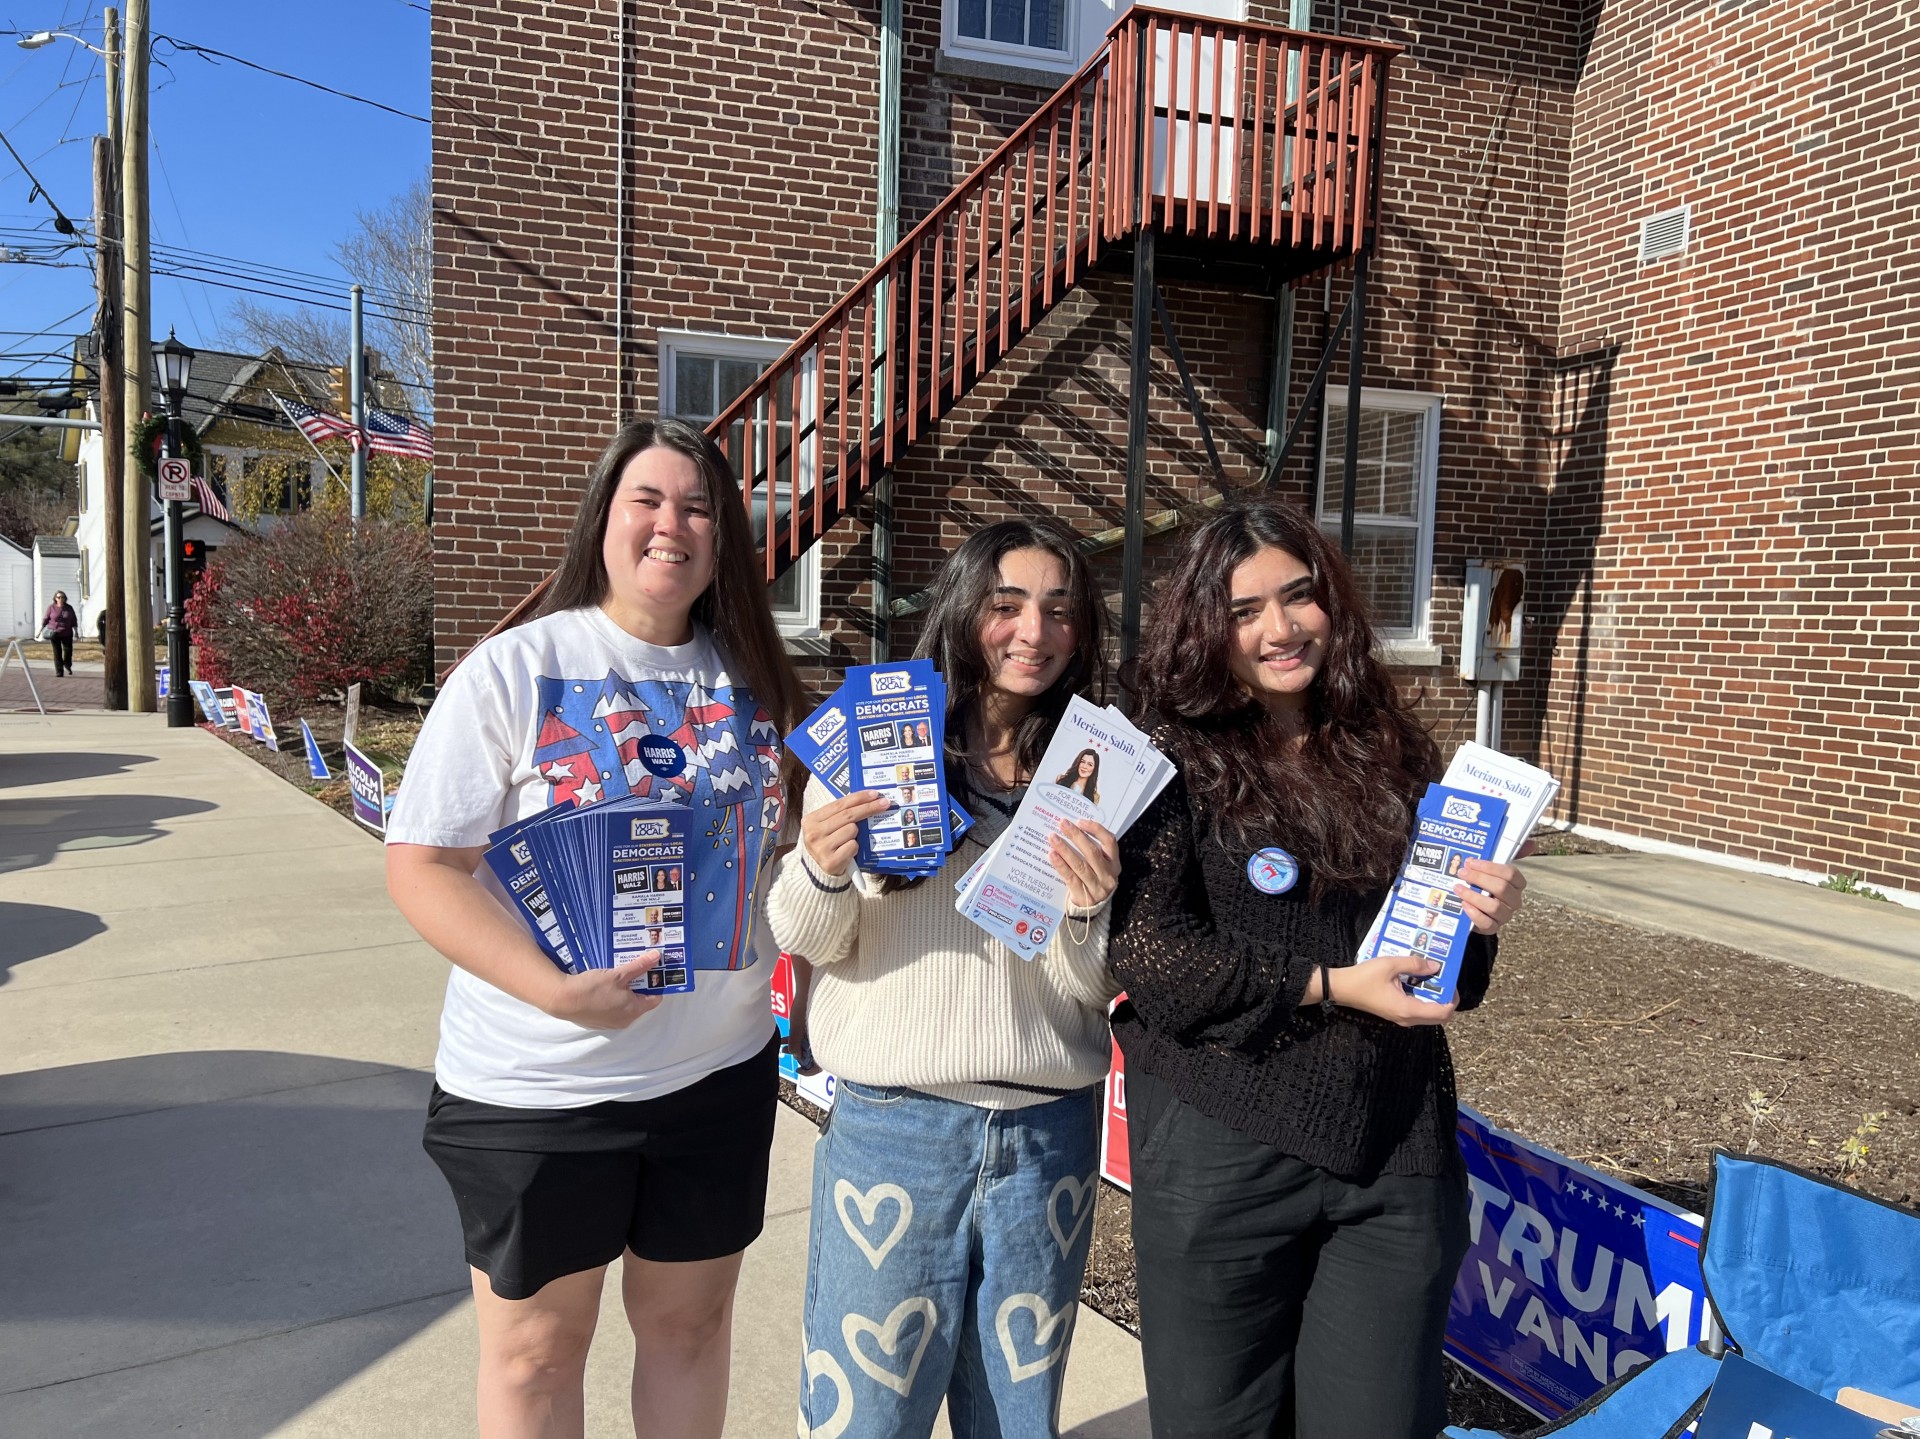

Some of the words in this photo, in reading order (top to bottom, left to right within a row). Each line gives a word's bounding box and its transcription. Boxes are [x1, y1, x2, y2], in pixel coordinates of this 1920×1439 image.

[876, 682, 905, 691] LOCAL
[856, 699, 929, 715] DEMOCRATS
[863, 727, 892, 742] HARRIS
[1071, 714, 1107, 742] Meriam
[1108, 735, 1135, 757] Sabih
[870, 738, 889, 747] WALZ
[644, 747, 676, 758] HARRIS
[813, 735, 848, 771] DEMOC
[1464, 763, 1502, 786] Meriam
[1503, 780, 1532, 798] Sabih
[1045, 791, 1094, 820] REPRESENTATIVE
[1058, 791, 1071, 801] FOR
[1072, 797, 1091, 811] STATE
[1034, 805, 1054, 818] MERIAM
[1447, 807, 1472, 819] LOCAL
[1420, 820, 1487, 845] DEMOCRATS
[613, 846, 684, 859] DEMOCRATS
[1416, 846, 1442, 860] HARRIS
[1419, 857, 1437, 865] WALZ
[618, 871, 645, 884] HARRIS
[1007, 874, 1041, 895] NOVEMBER
[1011, 866, 1027, 879] VOTE
[1027, 875, 1054, 893] TUESDAY
[538, 901, 550, 910] WA
[1477, 1259, 1650, 1386] VAN
